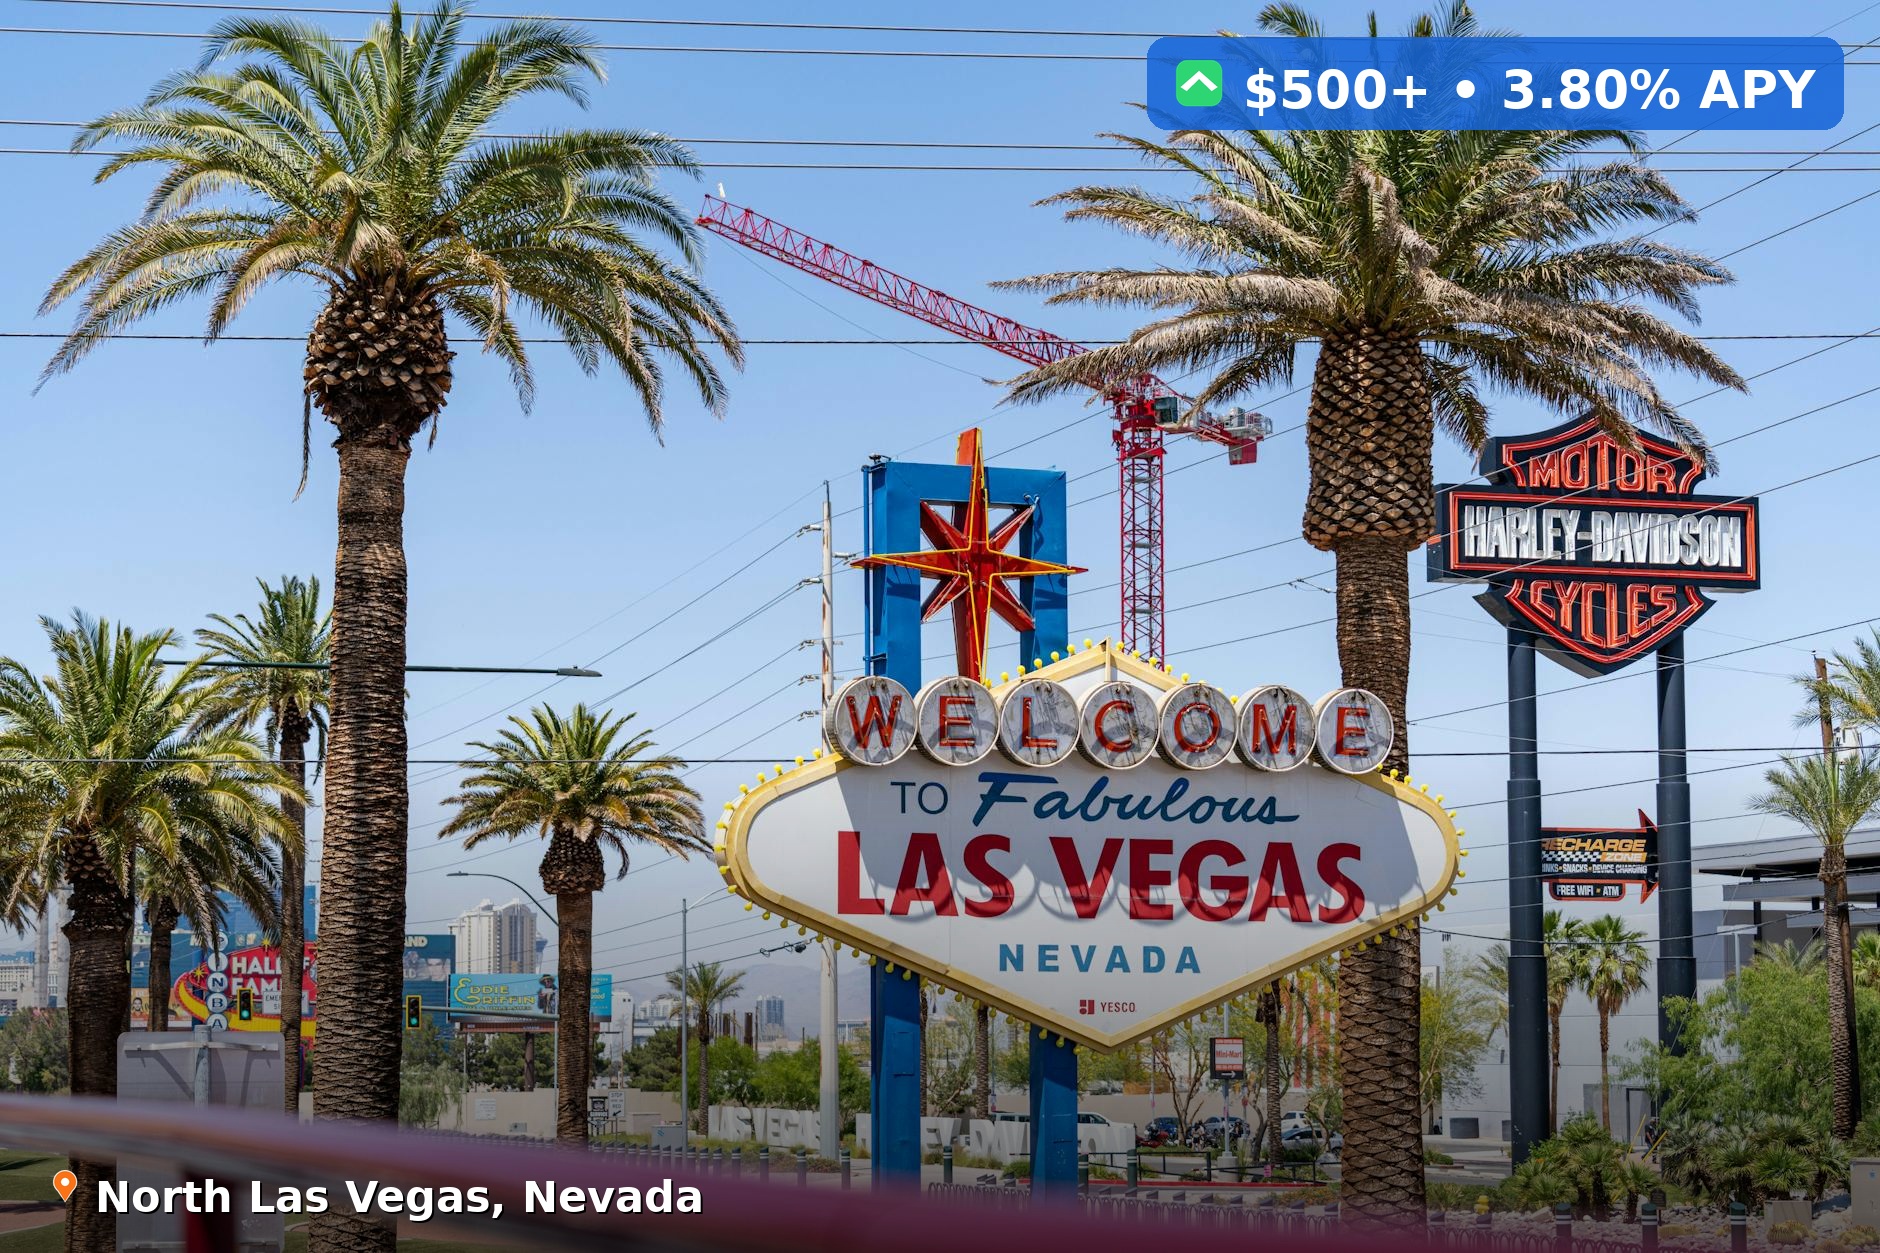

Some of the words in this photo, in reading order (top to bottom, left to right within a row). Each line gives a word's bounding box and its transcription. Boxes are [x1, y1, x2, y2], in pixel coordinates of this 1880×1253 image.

[1530, 433, 1677, 494] MOTOR
[1464, 505, 1742, 568] HARLEY-DAVIDSON
[1529, 580, 1678, 648] CYCLES
[846, 694, 1373, 756] WELCOME
[890, 781, 949, 815] TO
[972, 771, 1300, 827] Fabulous
[1541, 838, 1647, 852] RECHARGE
[1605, 852, 1643, 862] ZONE
[837, 830, 1015, 918] LAS
[1049, 836, 1367, 925] VEGAS
[1541, 863, 1559, 873] INKS
[1562, 864, 1588, 874] SNACKS
[1592, 864, 1615, 874] DEVICE
[1615, 865, 1648, 874] CHARGING
[1556, 885, 1576, 895] FREE
[1576, 885, 1594, 896] WIFI
[1603, 886, 1619, 896] ATM
[999, 943, 1202, 974] NEVADA
[231, 977, 283, 996] FAM
[454, 977, 510, 997] EDDIE
[466, 995, 536, 1006] GRIFFIN
[1100, 1001, 1136, 1013] YESCO
[1216, 1050, 1243, 1058] Mini-Mart
